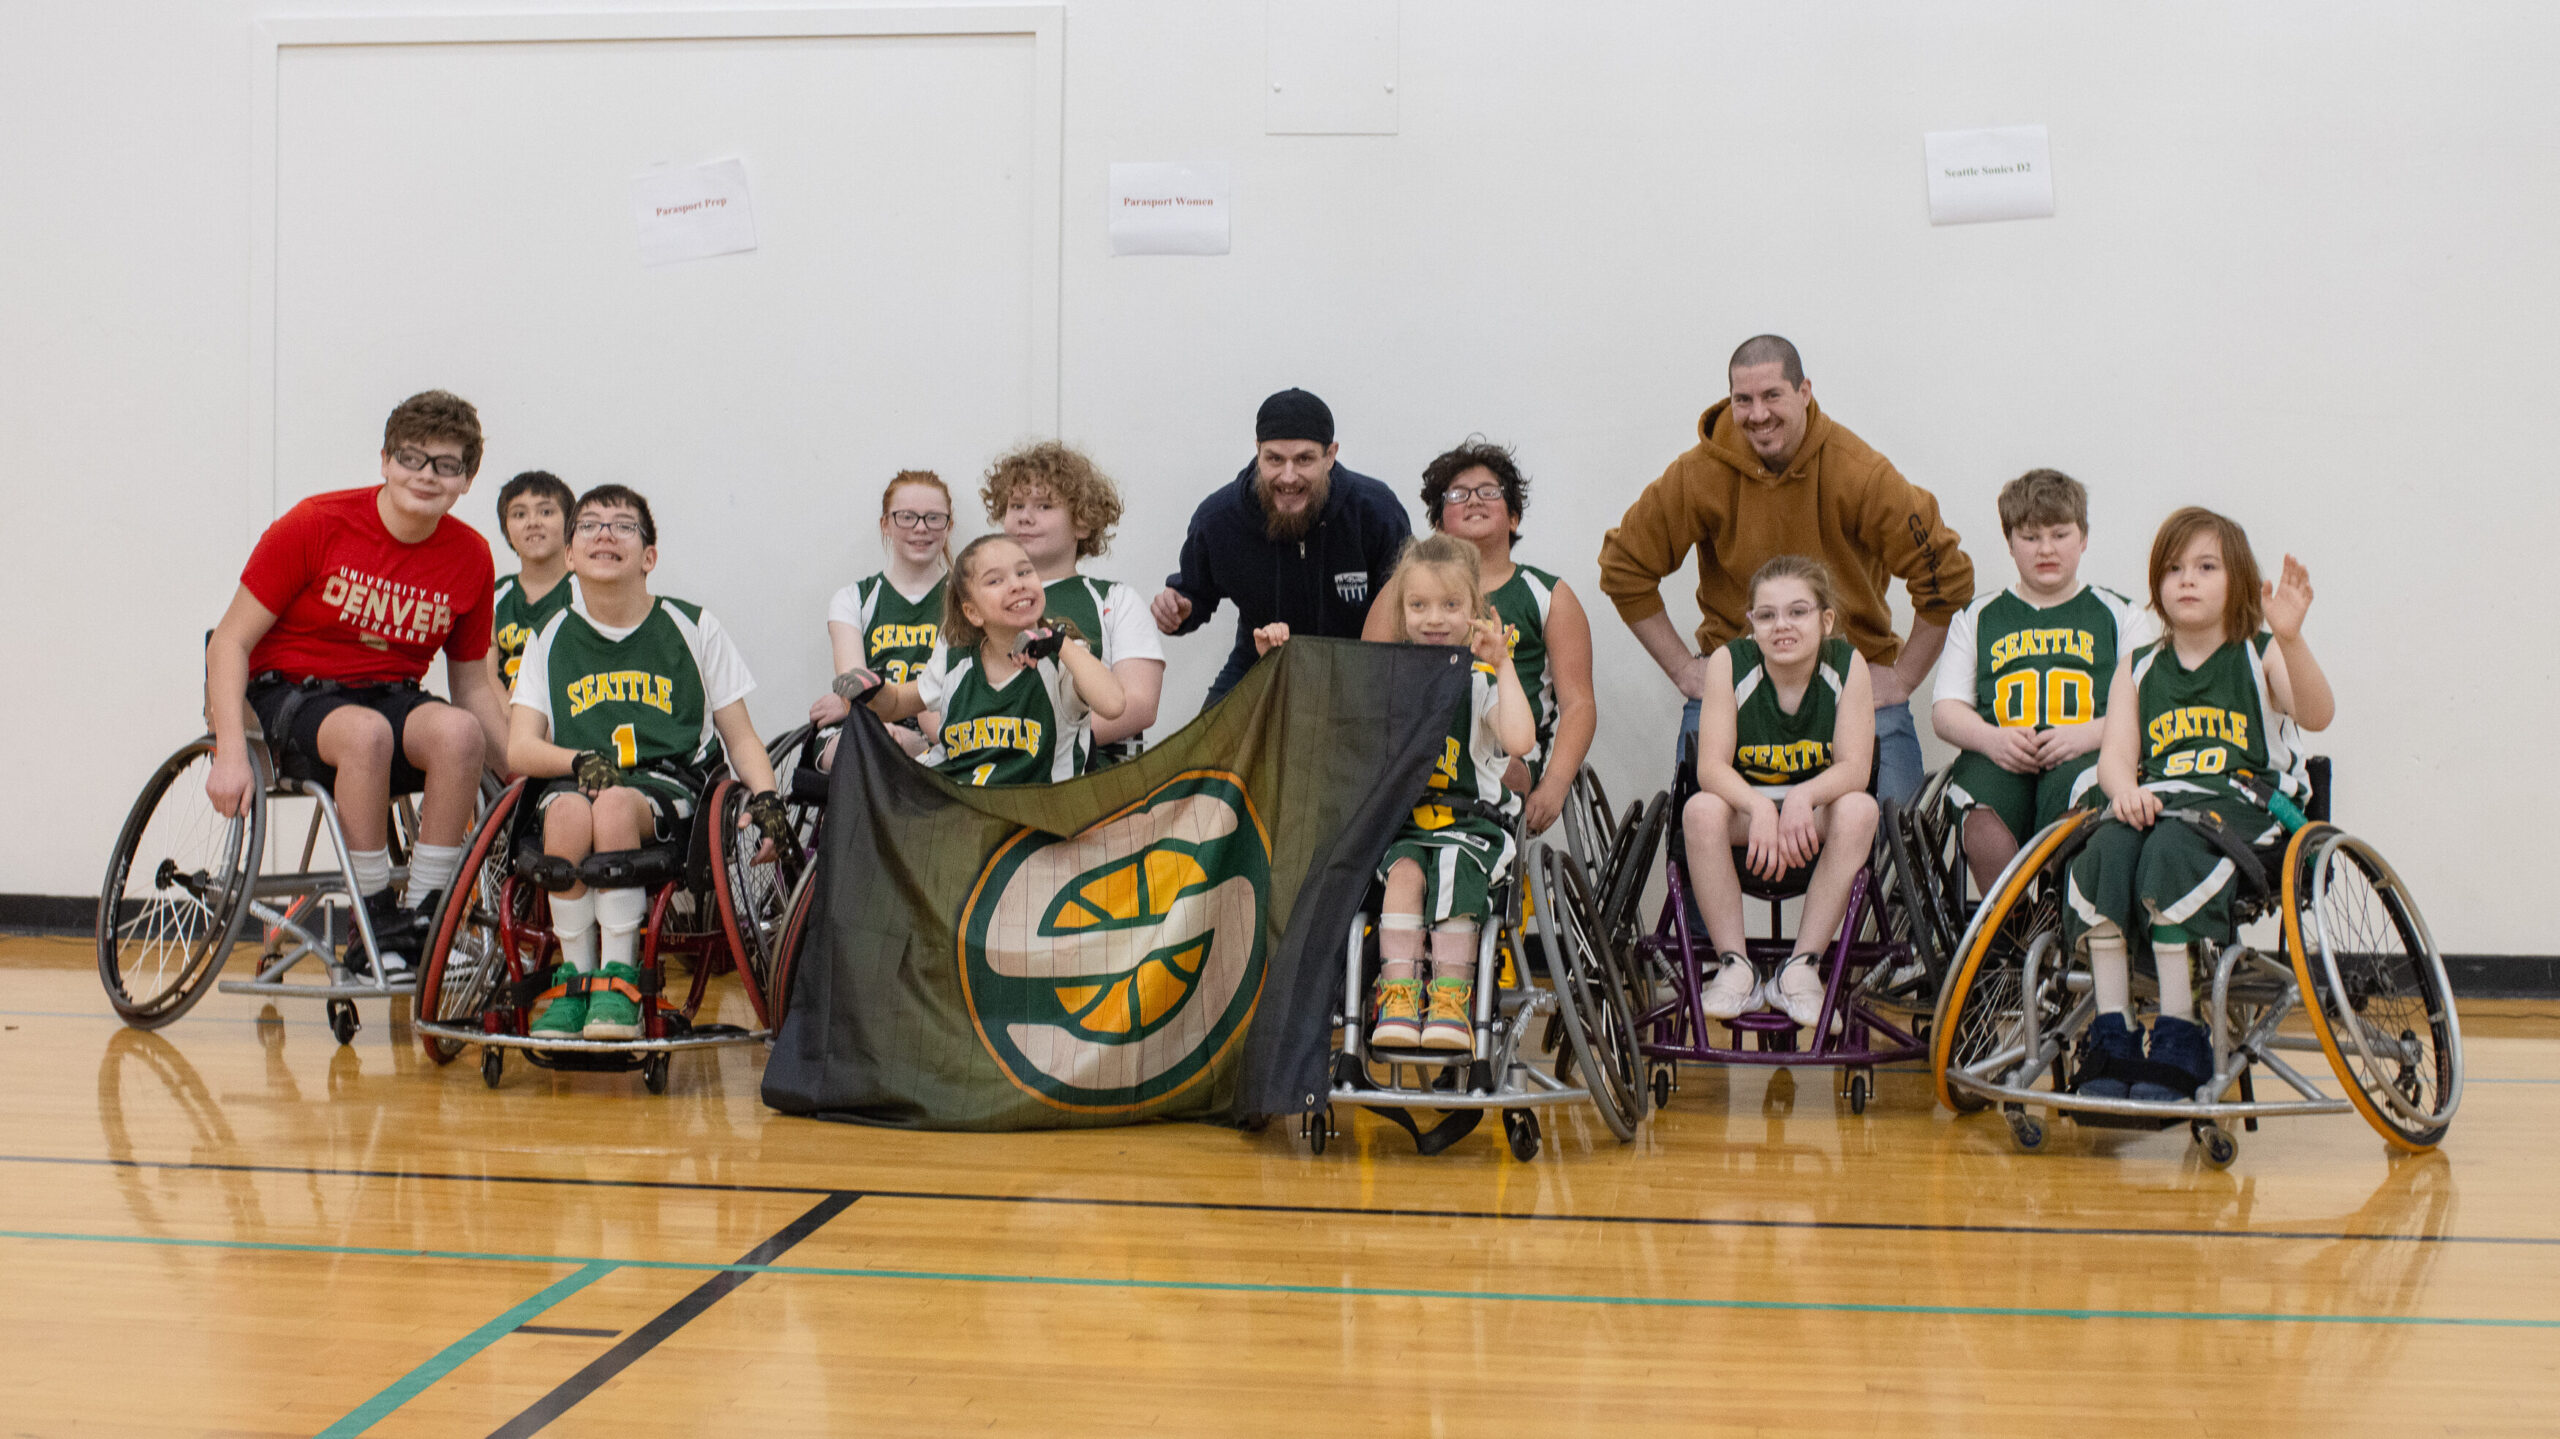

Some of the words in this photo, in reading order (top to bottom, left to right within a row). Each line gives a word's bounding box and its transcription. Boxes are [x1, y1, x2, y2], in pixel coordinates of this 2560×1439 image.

[1944, 167, 1979, 178] Seattle
[1981, 164, 2014, 176] Sonics
[2016, 162, 2031, 173] D2
[656, 200, 702, 216] Parasport
[705, 197, 727, 208] Prep
[1123, 197, 1172, 208] Parasport
[1175, 196, 1213, 206] Women
[322, 574, 451, 634] DENVER
[340, 565, 427, 600] UNIVERSITY
[434, 592, 449, 604] OF
[339, 611, 427, 643] PIONEERS
[1991, 628, 2094, 673] SEATTLE
[567, 670, 673, 718] SEATTLE
[1993, 666, 2094, 728] 00
[611, 723, 638, 769] 1
[945, 716, 1042, 760] SEATTLE
[2148, 706, 2248, 758] SEATTLE
[2163, 746, 2227, 777] 50
